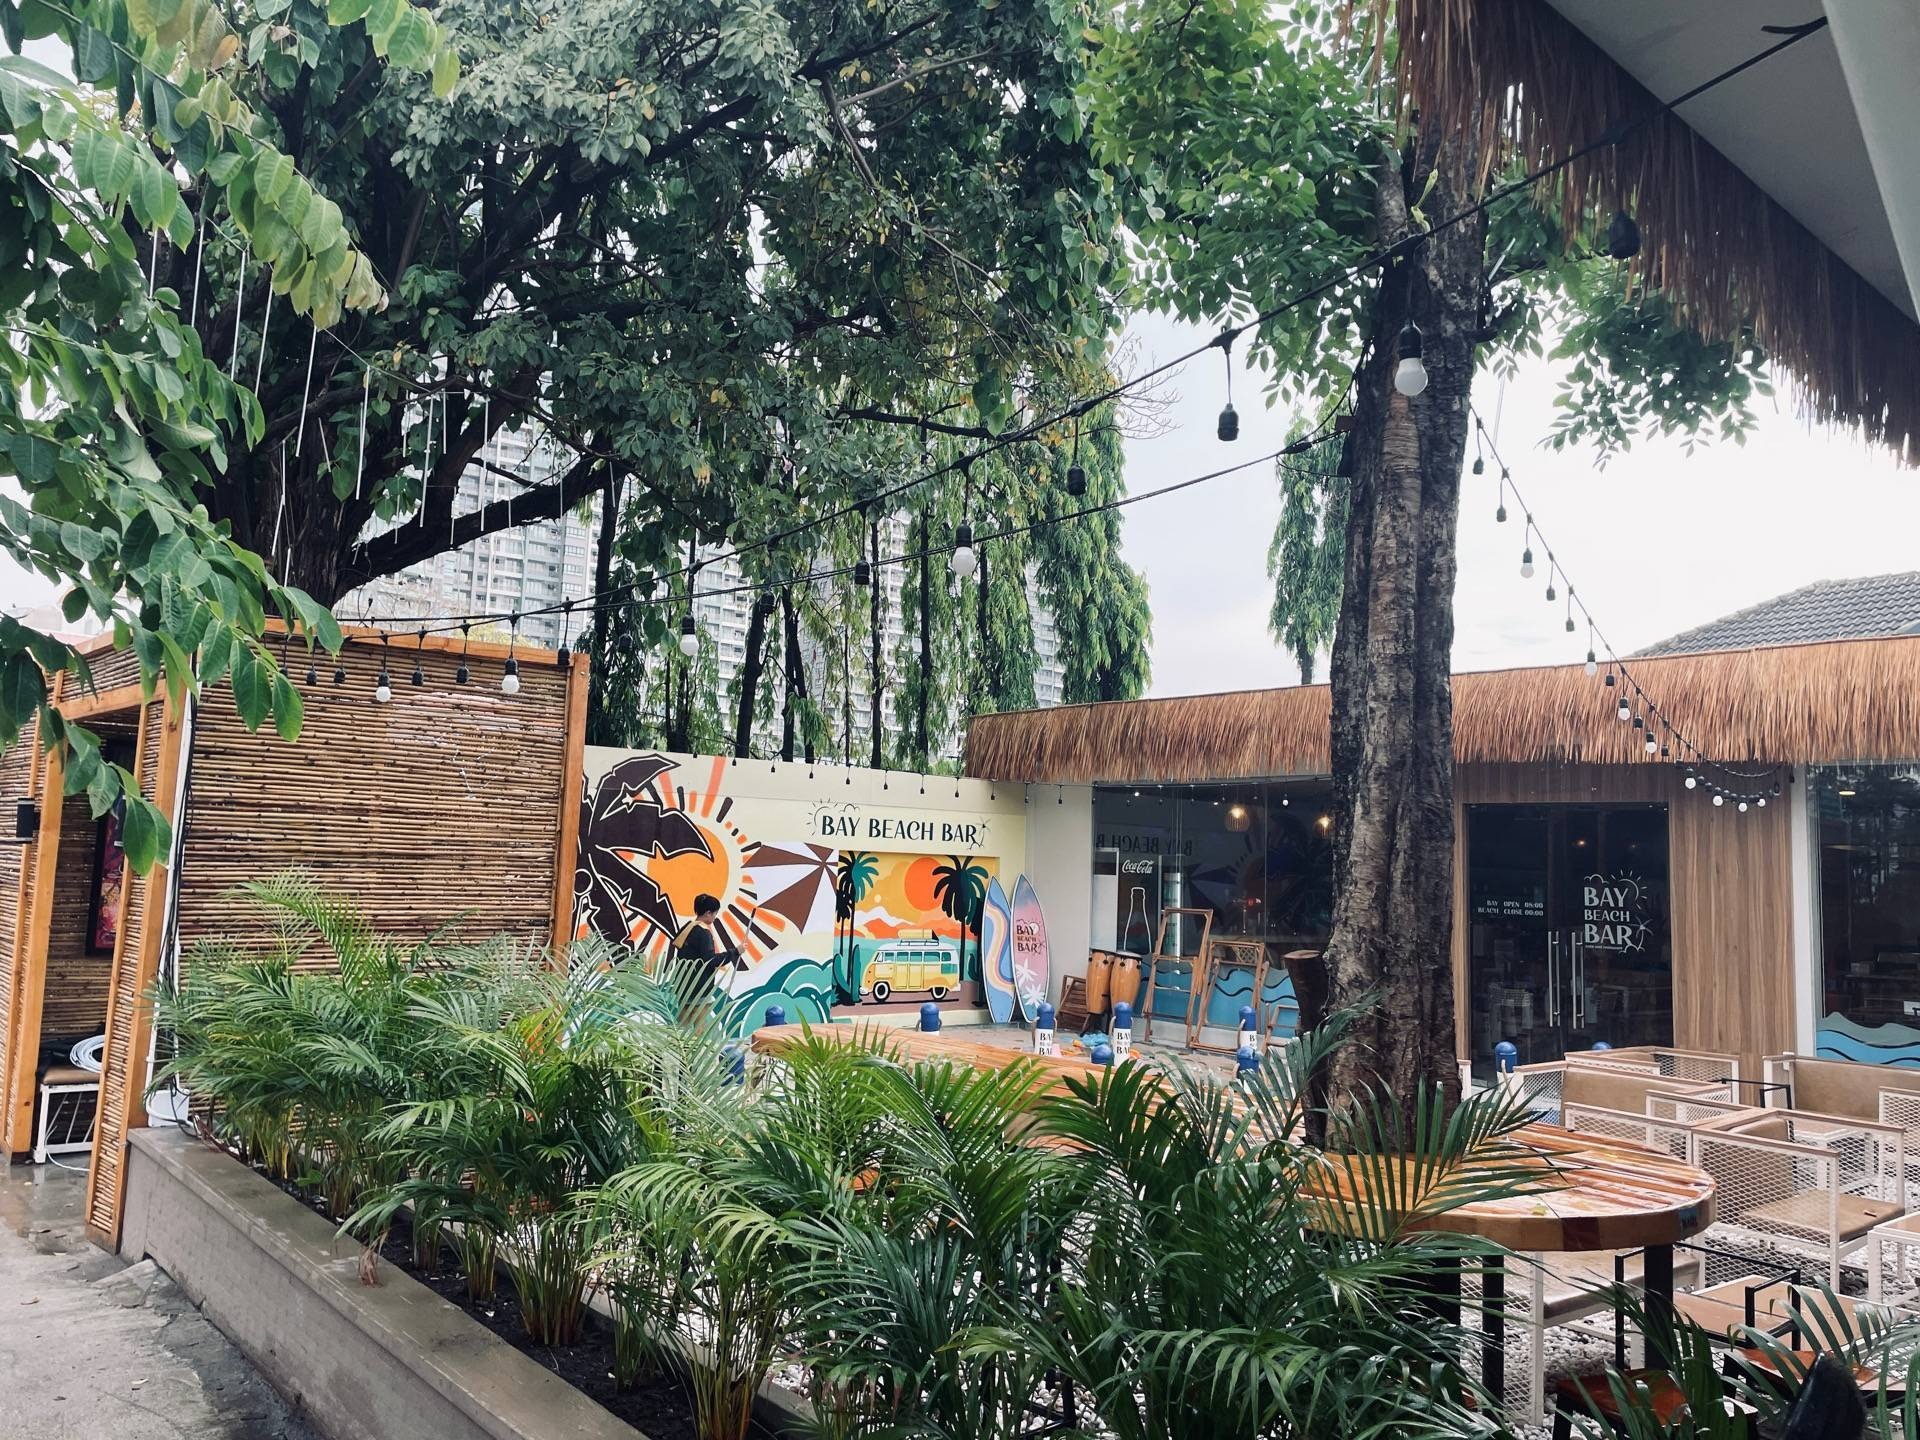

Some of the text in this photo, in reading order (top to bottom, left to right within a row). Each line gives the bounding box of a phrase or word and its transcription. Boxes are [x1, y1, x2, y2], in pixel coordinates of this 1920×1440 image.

[821, 815, 977, 843] BAY BEACH BAR
[1122, 860, 1154, 874] CocaCola
[1584, 886, 1629, 907] BAY
[1503, 908, 1523, 916] CLOSE
[1584, 909, 1630, 922] BEACH
[1016, 924, 1034, 936] BAY
[1584, 923, 1633, 945] BAR
[1017, 942, 1038, 953] BAR
